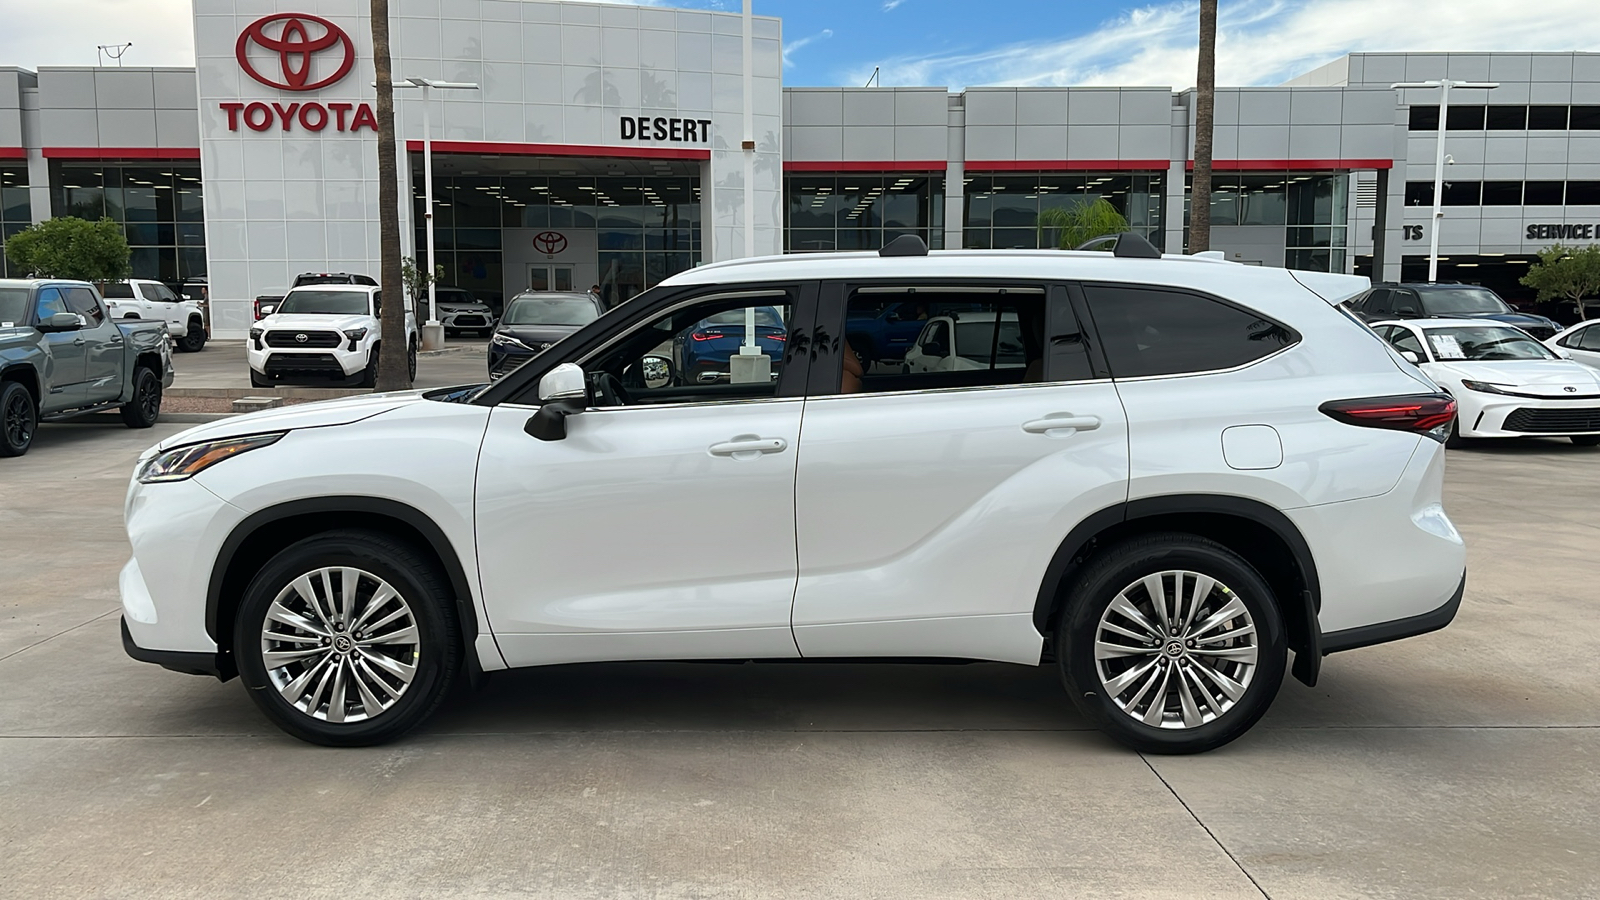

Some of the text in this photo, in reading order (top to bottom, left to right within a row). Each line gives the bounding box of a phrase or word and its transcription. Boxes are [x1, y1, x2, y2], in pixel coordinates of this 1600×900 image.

[219, 101, 379, 132] TOYOTA
[620, 116, 712, 142] DESERT
[1526, 223, 1593, 240] SERVICE
